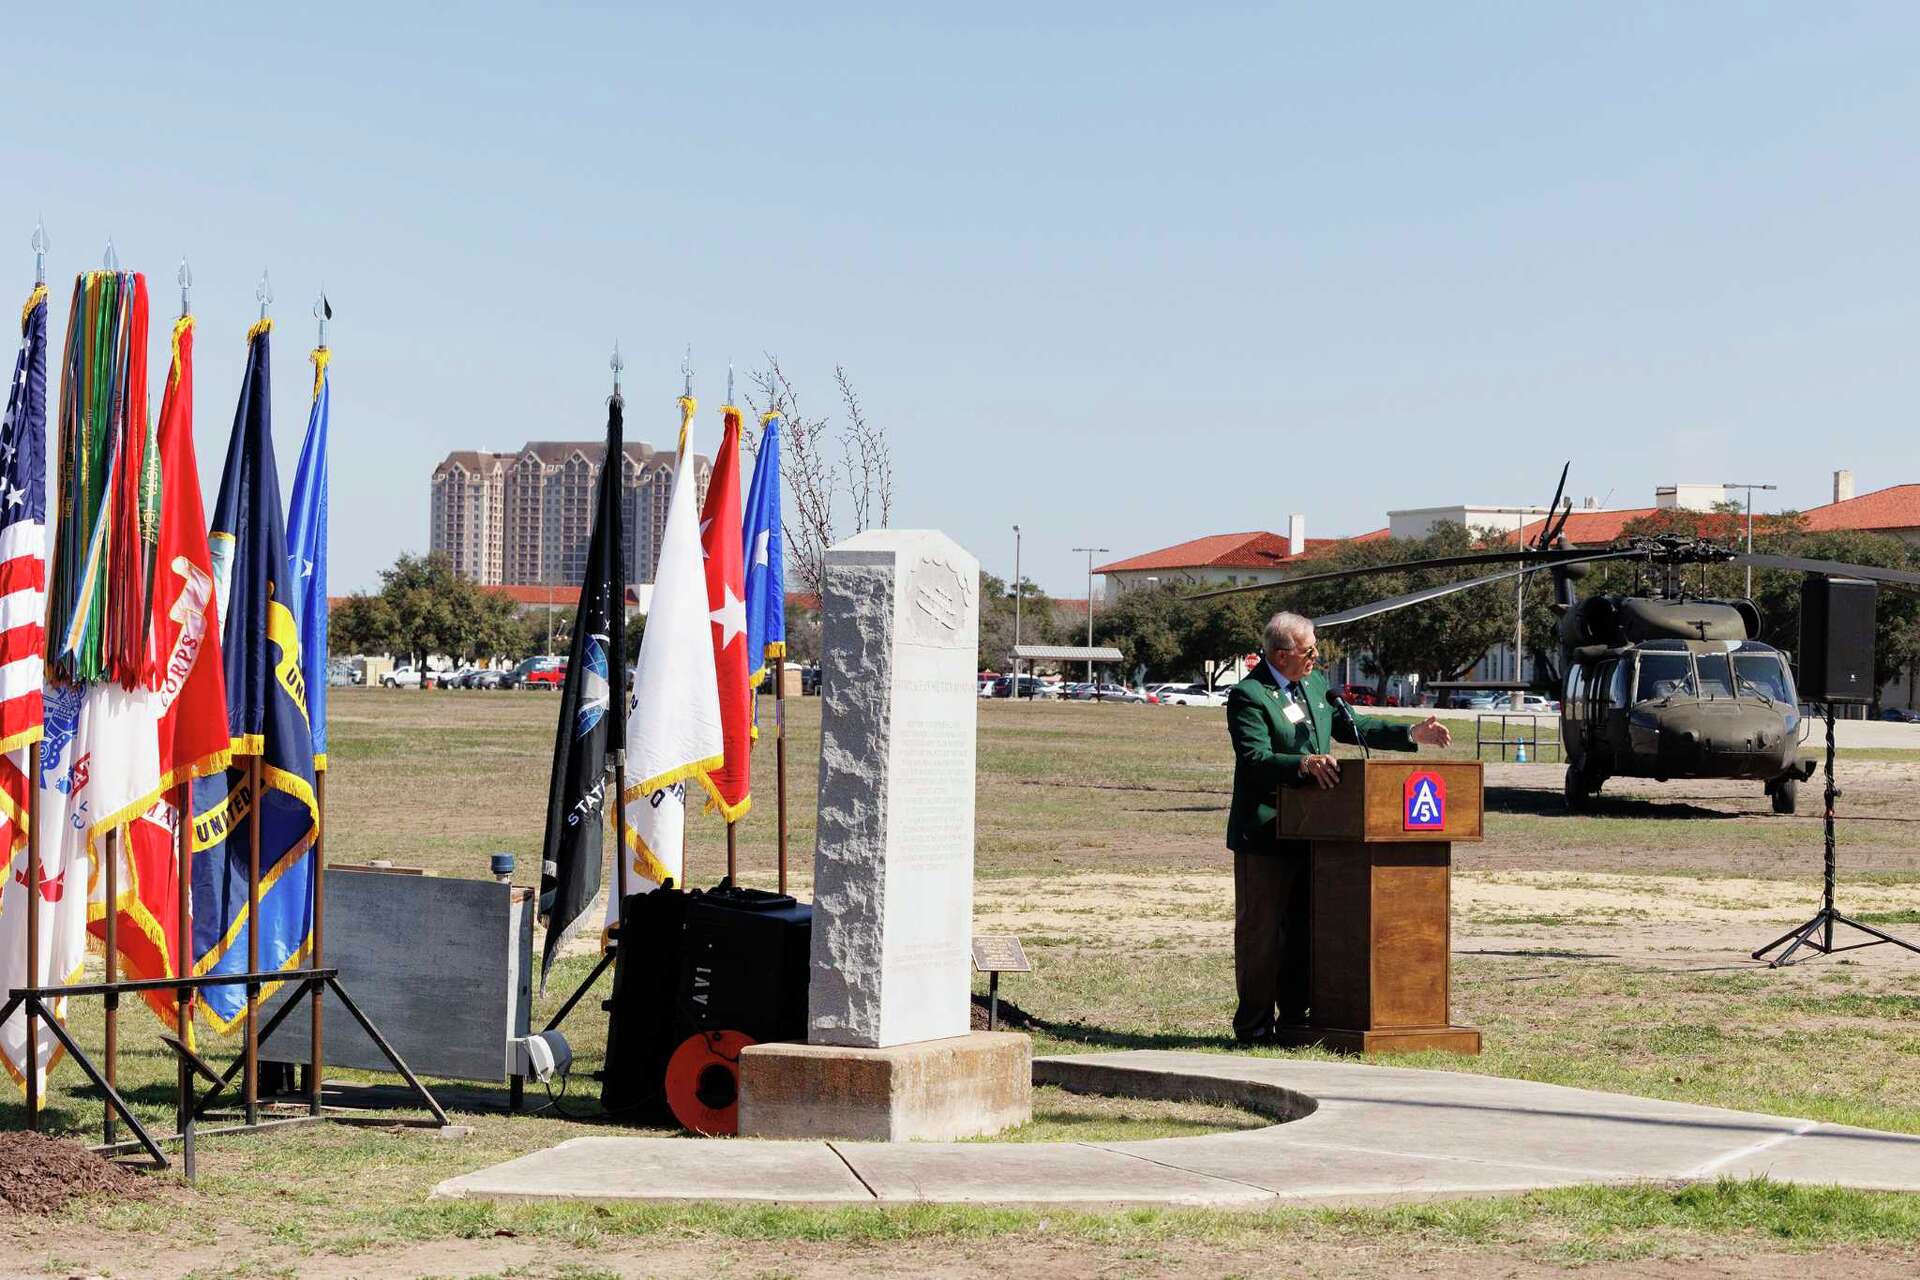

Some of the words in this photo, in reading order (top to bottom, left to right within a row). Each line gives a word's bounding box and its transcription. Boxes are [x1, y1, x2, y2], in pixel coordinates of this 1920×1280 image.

[142, 508, 157, 543] 1847
[161, 633, 198, 707] CORPS
[196, 785, 252, 843] UNITED
[1411, 780, 1439, 817] A
[1420, 804, 1431, 822] 5
[692, 966, 712, 1006] AVI
